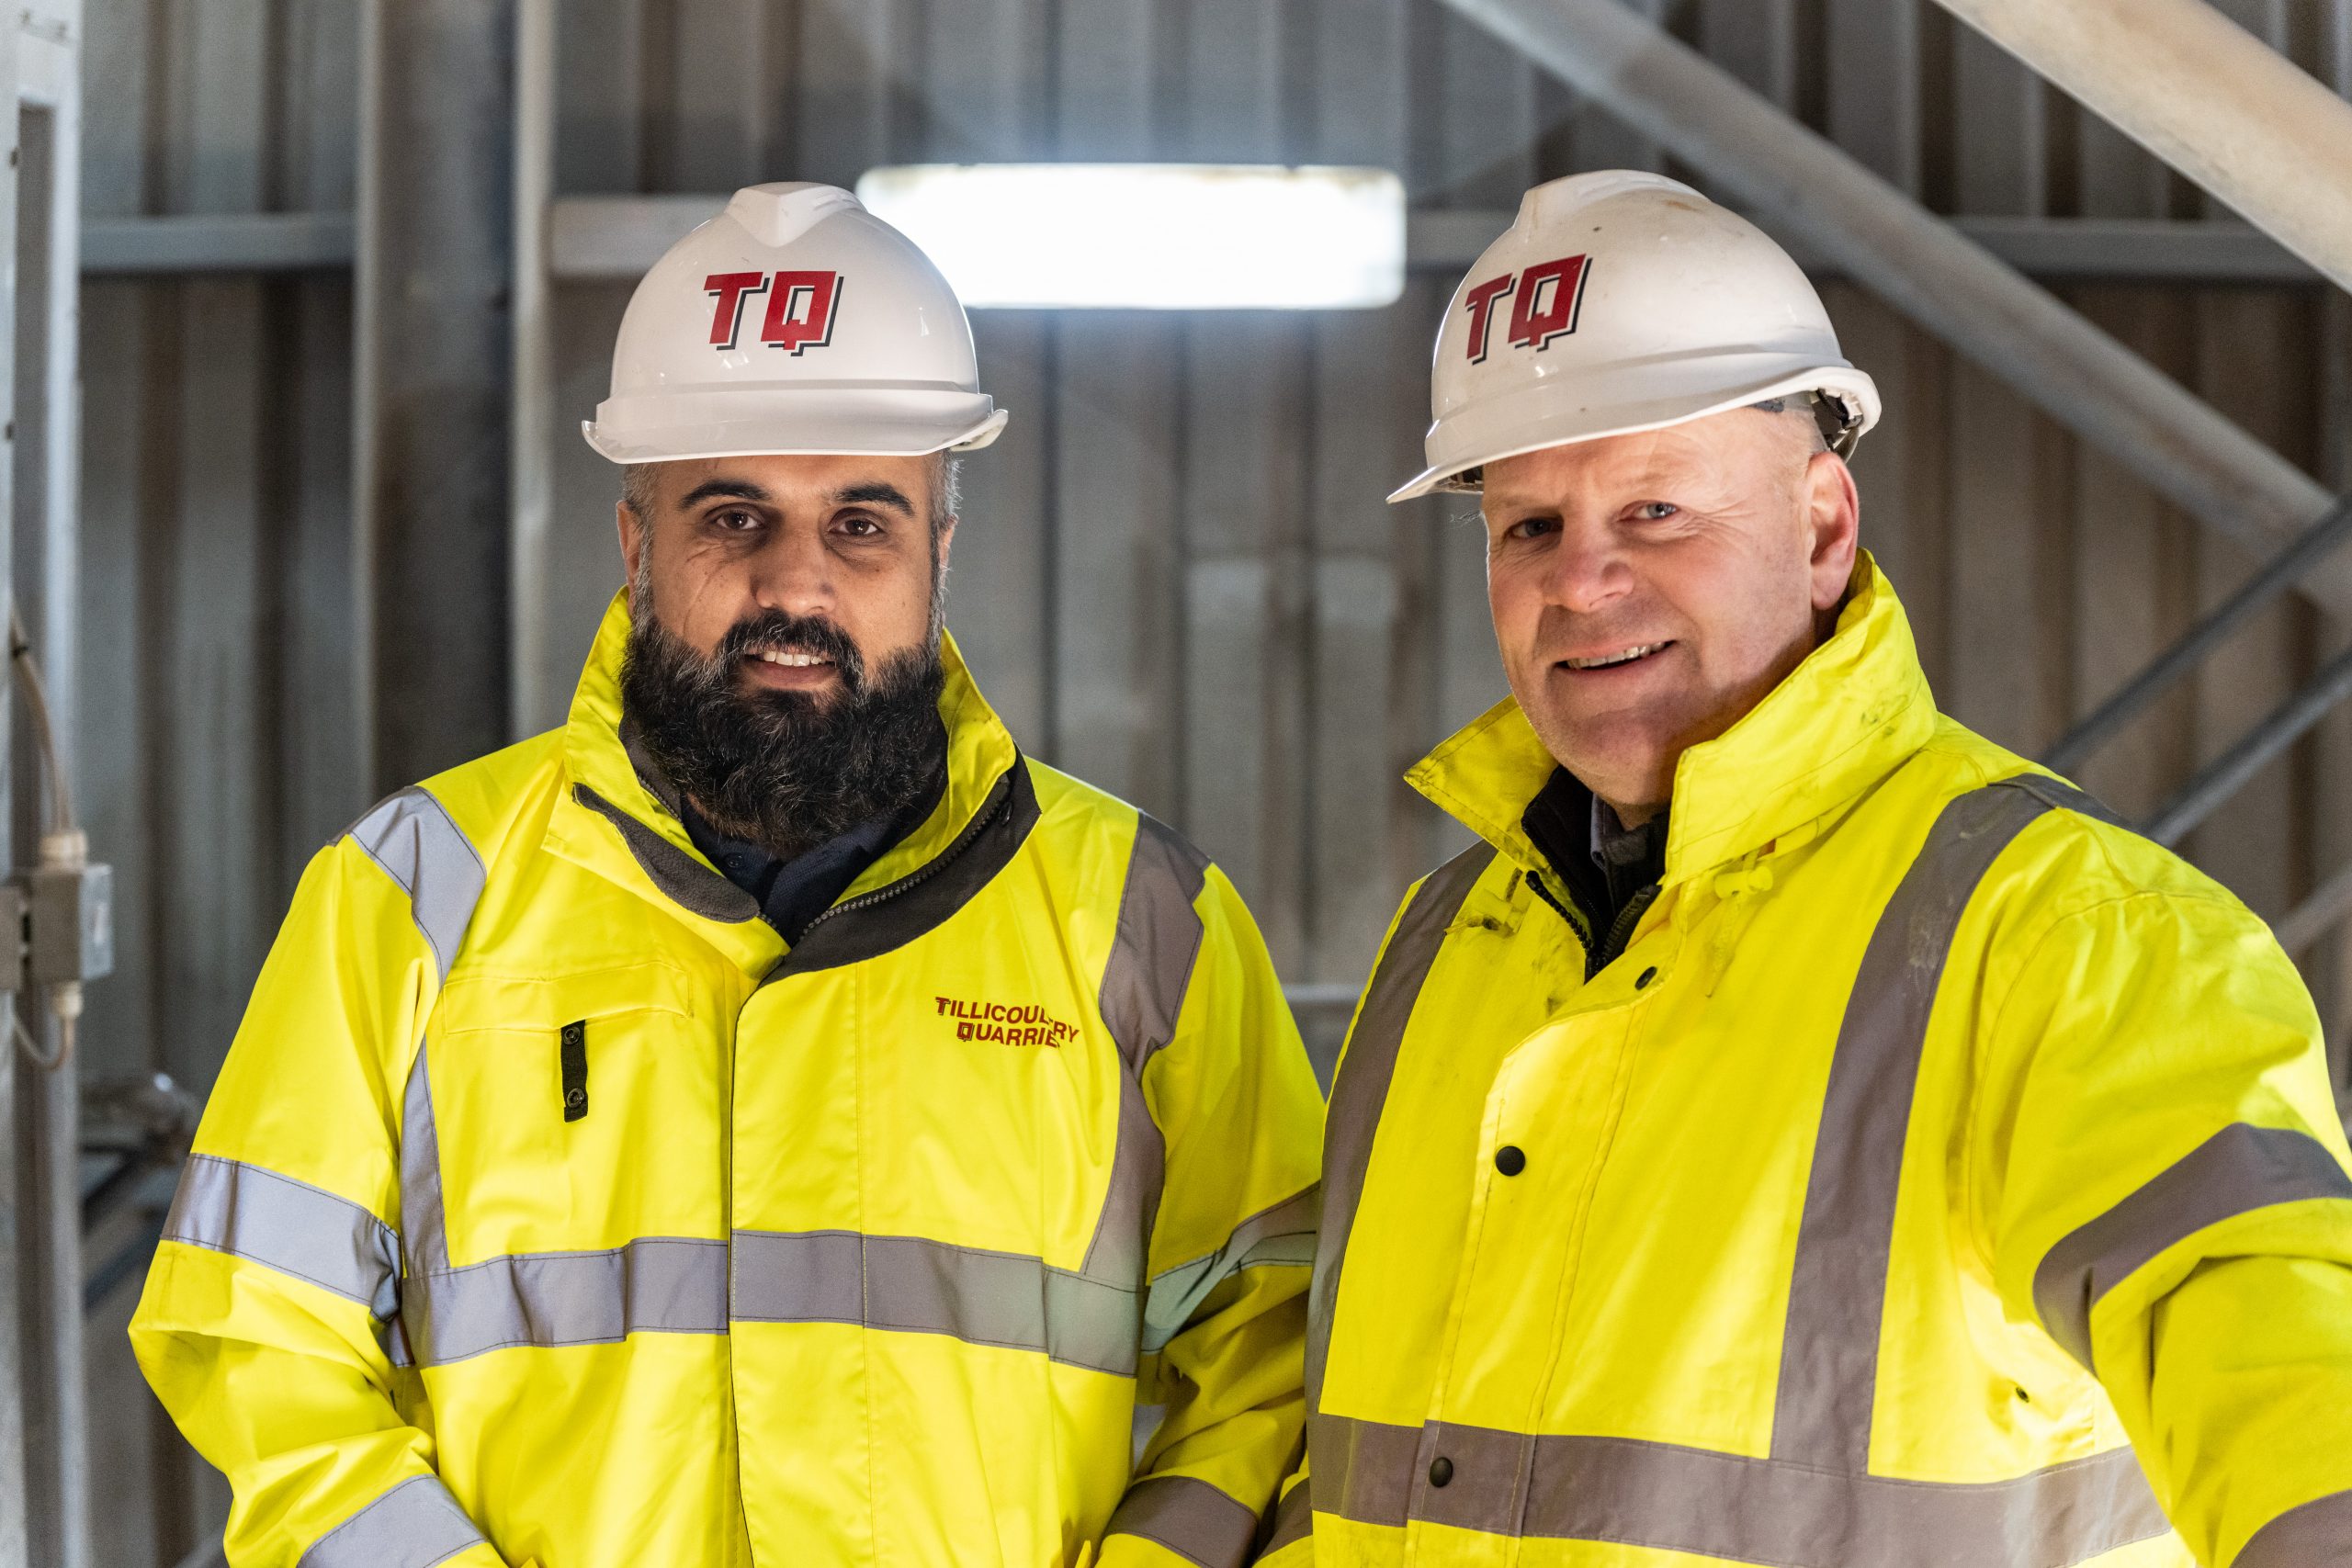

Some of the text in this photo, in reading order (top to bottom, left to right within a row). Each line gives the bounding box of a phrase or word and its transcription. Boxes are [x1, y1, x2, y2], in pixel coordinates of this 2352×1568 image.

[704, 270, 844, 357] TQ
[1464, 253, 1593, 366] TQ
[934, 996, 1080, 1043] TILLICOULRY
[956, 1021, 1060, 1048] QUARRIE
